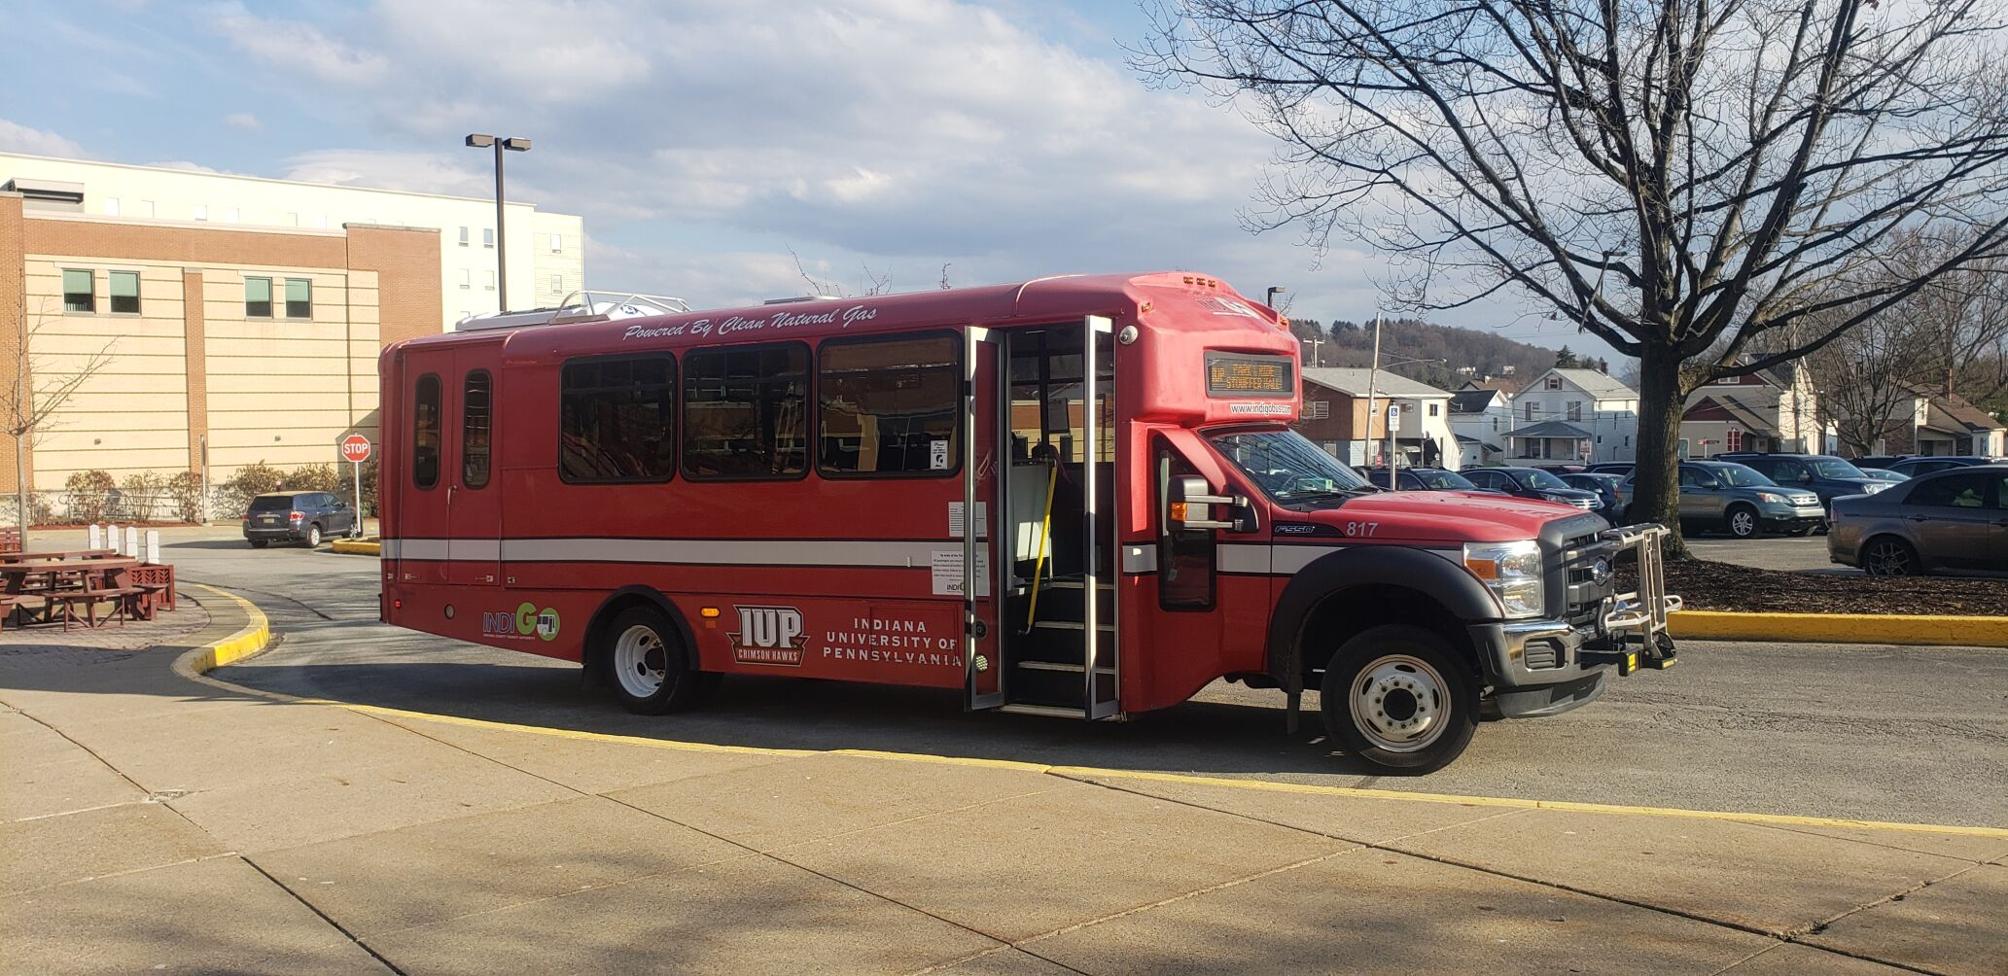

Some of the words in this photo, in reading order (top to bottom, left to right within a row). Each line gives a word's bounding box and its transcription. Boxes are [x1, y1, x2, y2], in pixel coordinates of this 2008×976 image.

[623, 322, 689, 341] Powered
[690, 319, 713, 338] By
[718, 315, 765, 335] Clean
[770, 308, 841, 329] Natural
[842, 304, 877, 328] Gas
[344, 443, 368, 455] STOP
[1346, 521, 1378, 537] 817
[738, 608, 801, 649] IUP
[854, 618, 927, 633] INDIANA
[826, 631, 932, 649] UNIVERSITY
[938, 638, 957, 650] OF
[738, 649, 770, 660] CRIMSON
[772, 650, 798, 662] HAWKS
[823, 646, 962, 667] PENNSYLVANIA
